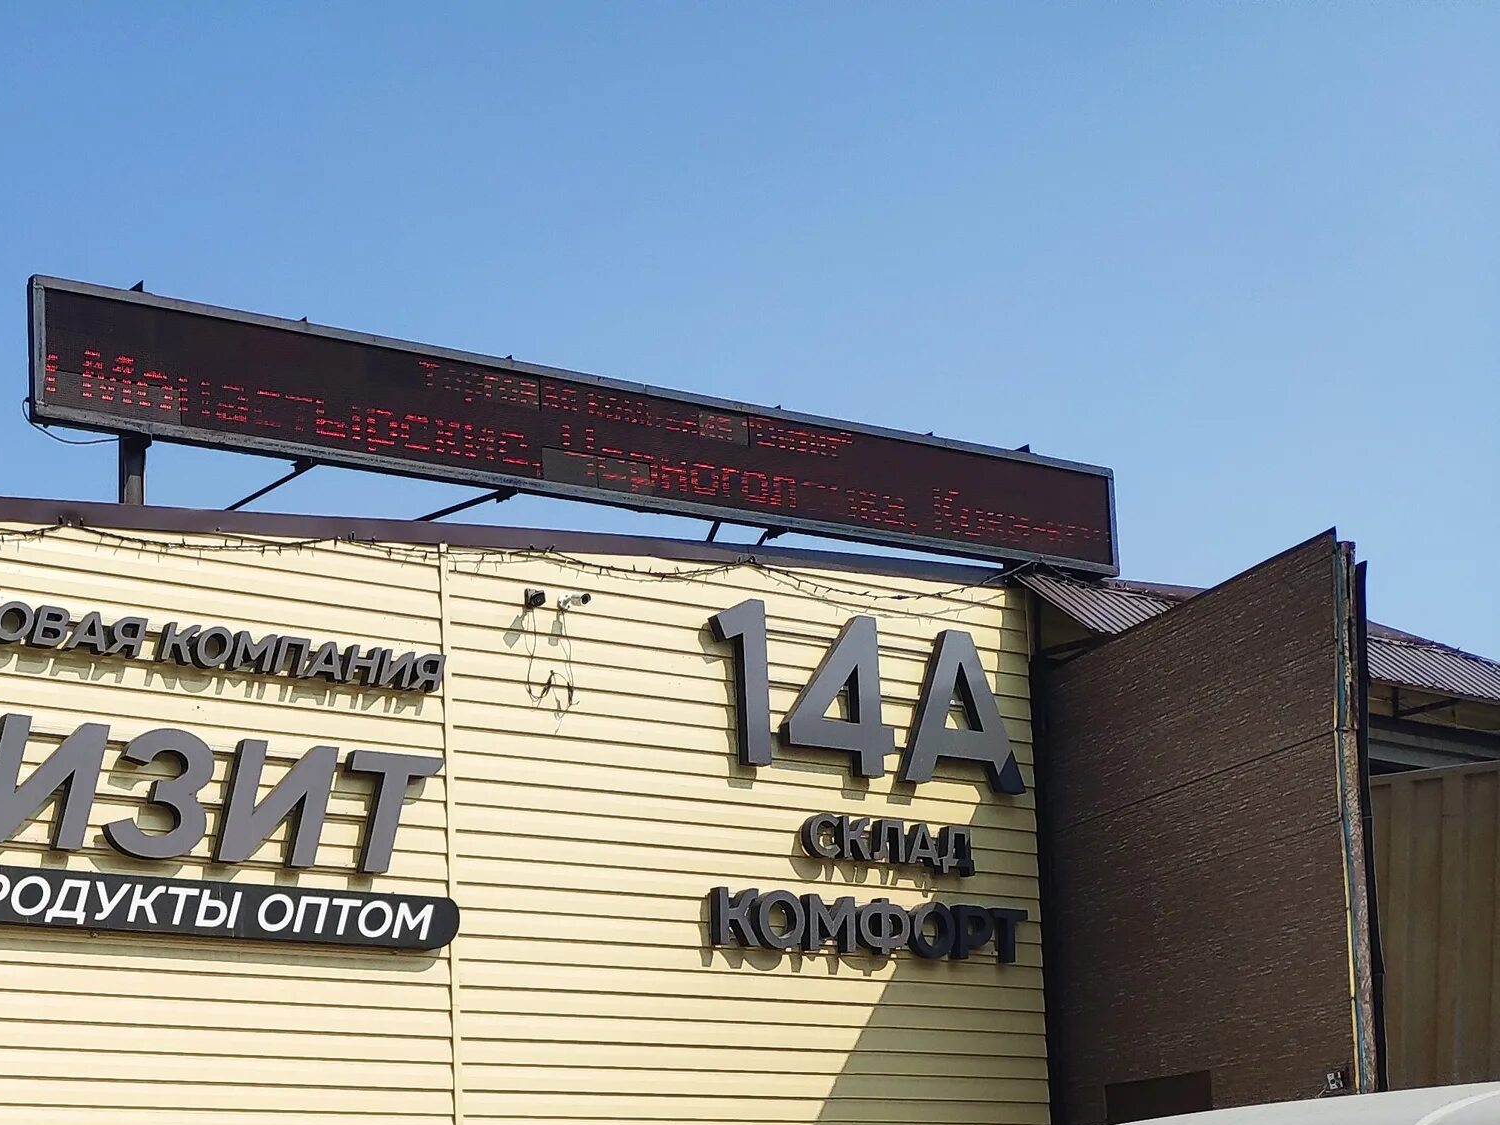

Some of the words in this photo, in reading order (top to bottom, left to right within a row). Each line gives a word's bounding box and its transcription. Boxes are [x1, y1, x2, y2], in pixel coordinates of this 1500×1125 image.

[158, 621, 446, 694] КОМПАНИЯ
[707, 598, 1027, 795] 14А
[801, 812, 976, 878] СКЛАД
[257, 892, 435, 943] ОПТОМ
[709, 886, 1029, 964] КОМФОРТ
